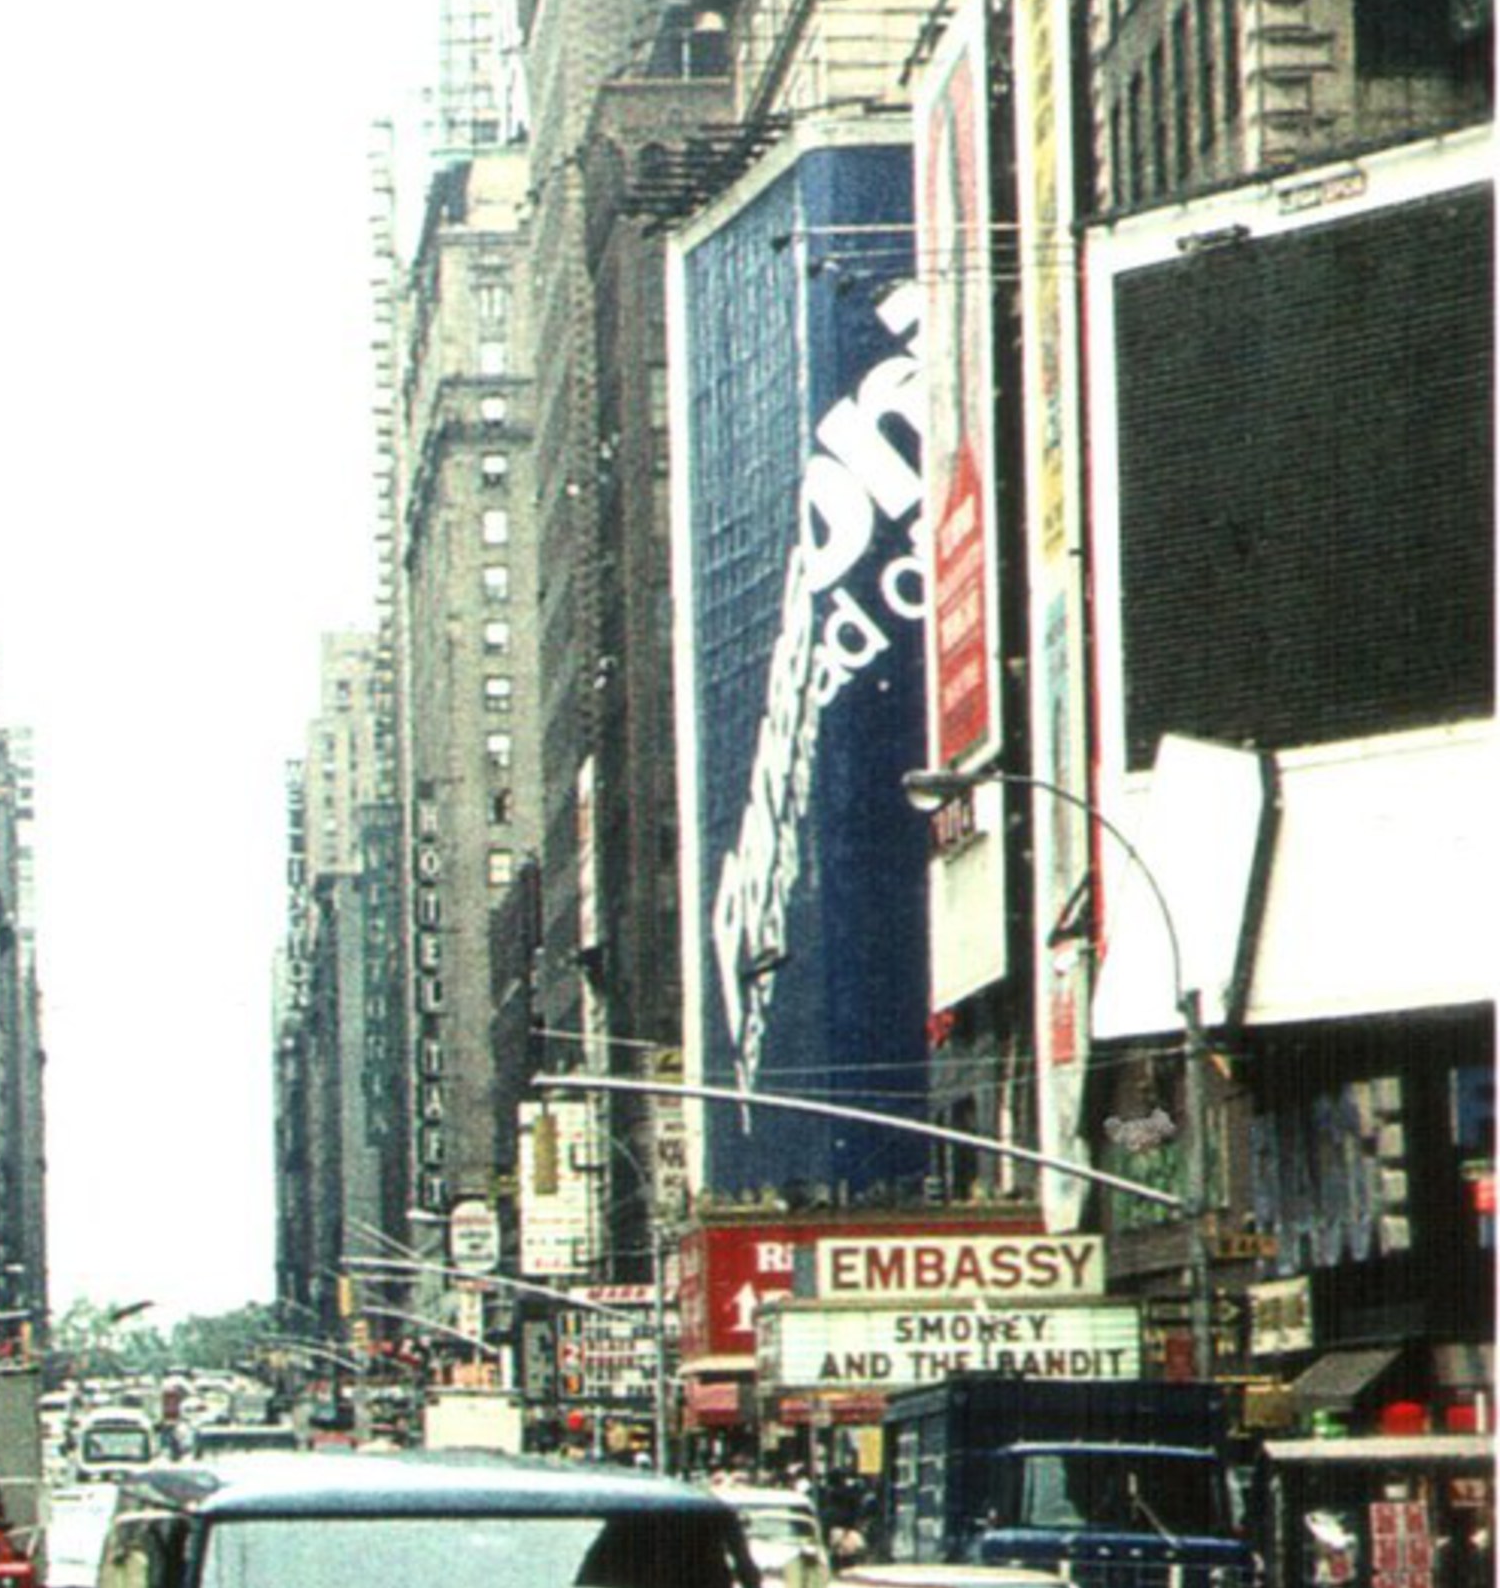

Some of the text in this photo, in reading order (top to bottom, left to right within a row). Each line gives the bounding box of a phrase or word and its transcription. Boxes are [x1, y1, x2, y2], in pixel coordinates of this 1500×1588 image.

[830, 1242, 1095, 1291] EMBASSY
[895, 1314, 1051, 1344] SMOKEY
[817, 1347, 1128, 1380] AND THE BANDIT
